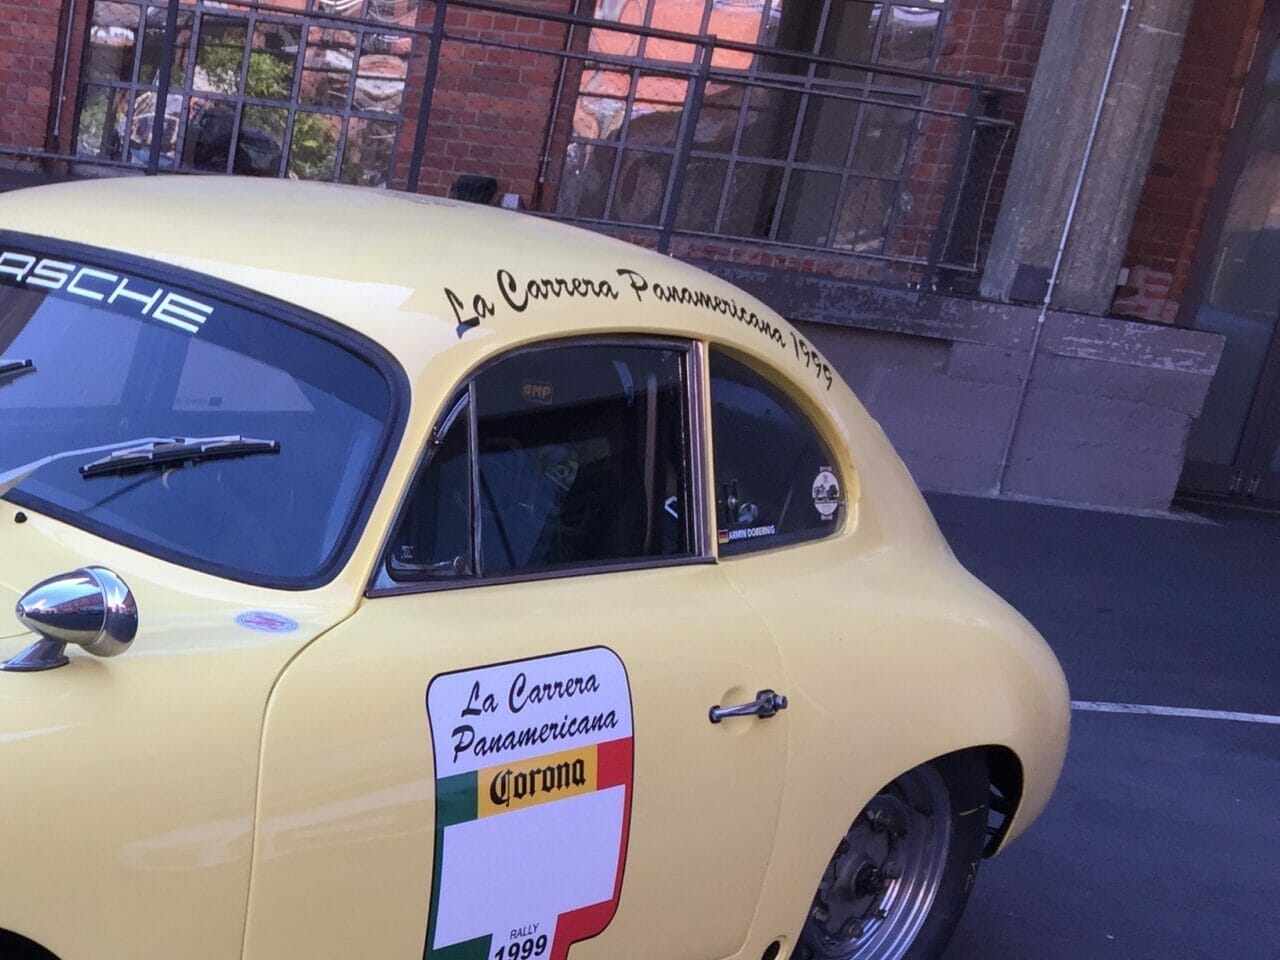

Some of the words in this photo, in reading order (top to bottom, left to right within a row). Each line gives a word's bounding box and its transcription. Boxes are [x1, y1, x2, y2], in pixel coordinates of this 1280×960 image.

[445, 287, 495, 339] La
[497, 269, 619, 312] Carrera
[617, 268, 787, 348] Panamericana
[793, 331, 833, 391] 1999
[461, 680, 498, 718] La
[508, 672, 600, 713] Carrera
[451, 710, 619, 764] Panamericana
[489, 758, 586, 807] Corona
[510, 923, 540, 940] RALLY
